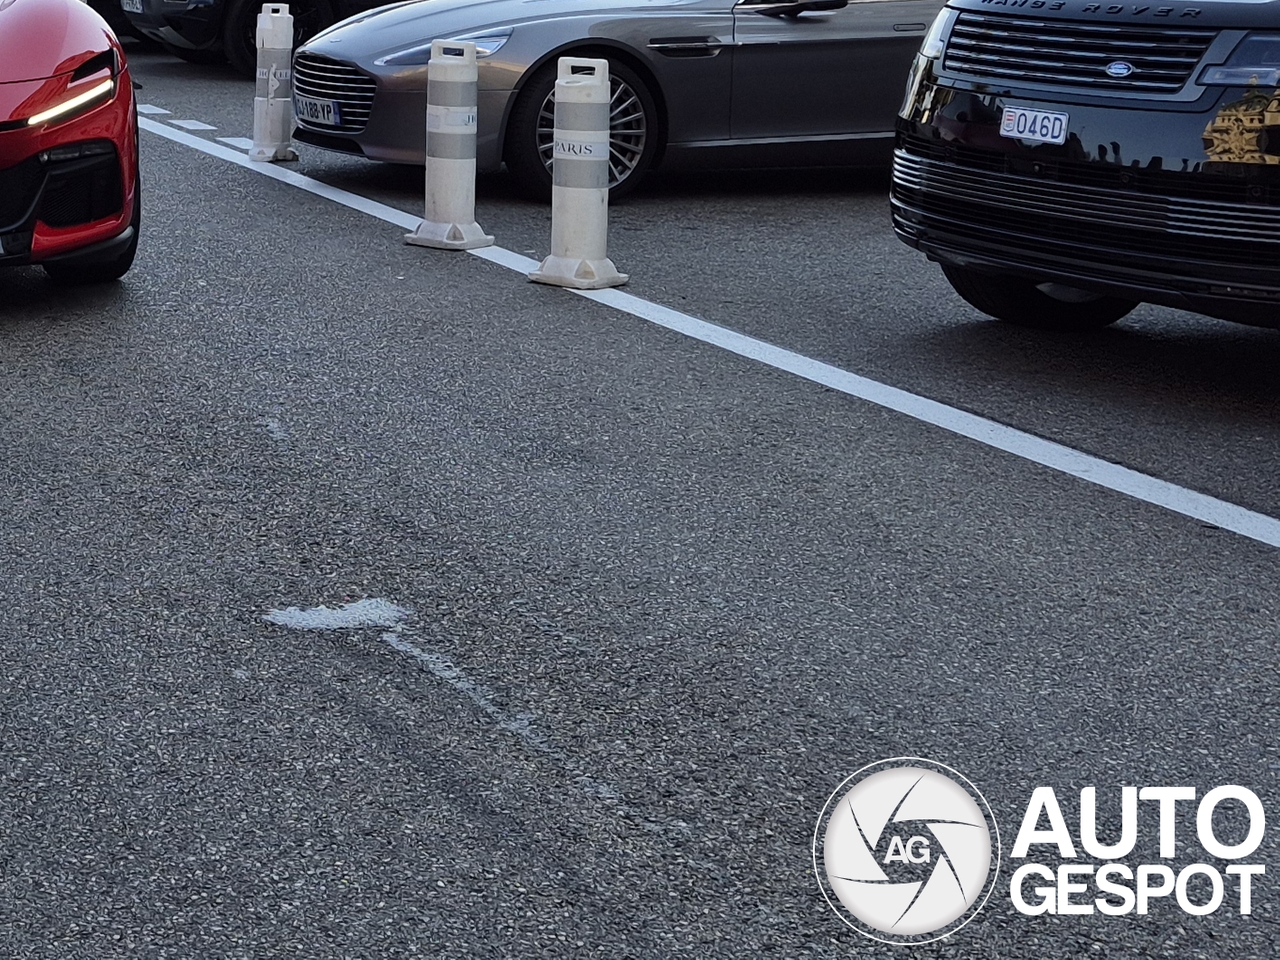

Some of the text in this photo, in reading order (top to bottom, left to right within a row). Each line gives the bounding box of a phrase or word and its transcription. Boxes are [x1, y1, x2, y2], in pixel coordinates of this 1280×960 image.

[1081, 2, 1203, 18] ROVER
[1016, 113, 1063, 139] 046D
[555, 141, 593, 155] PARIS
